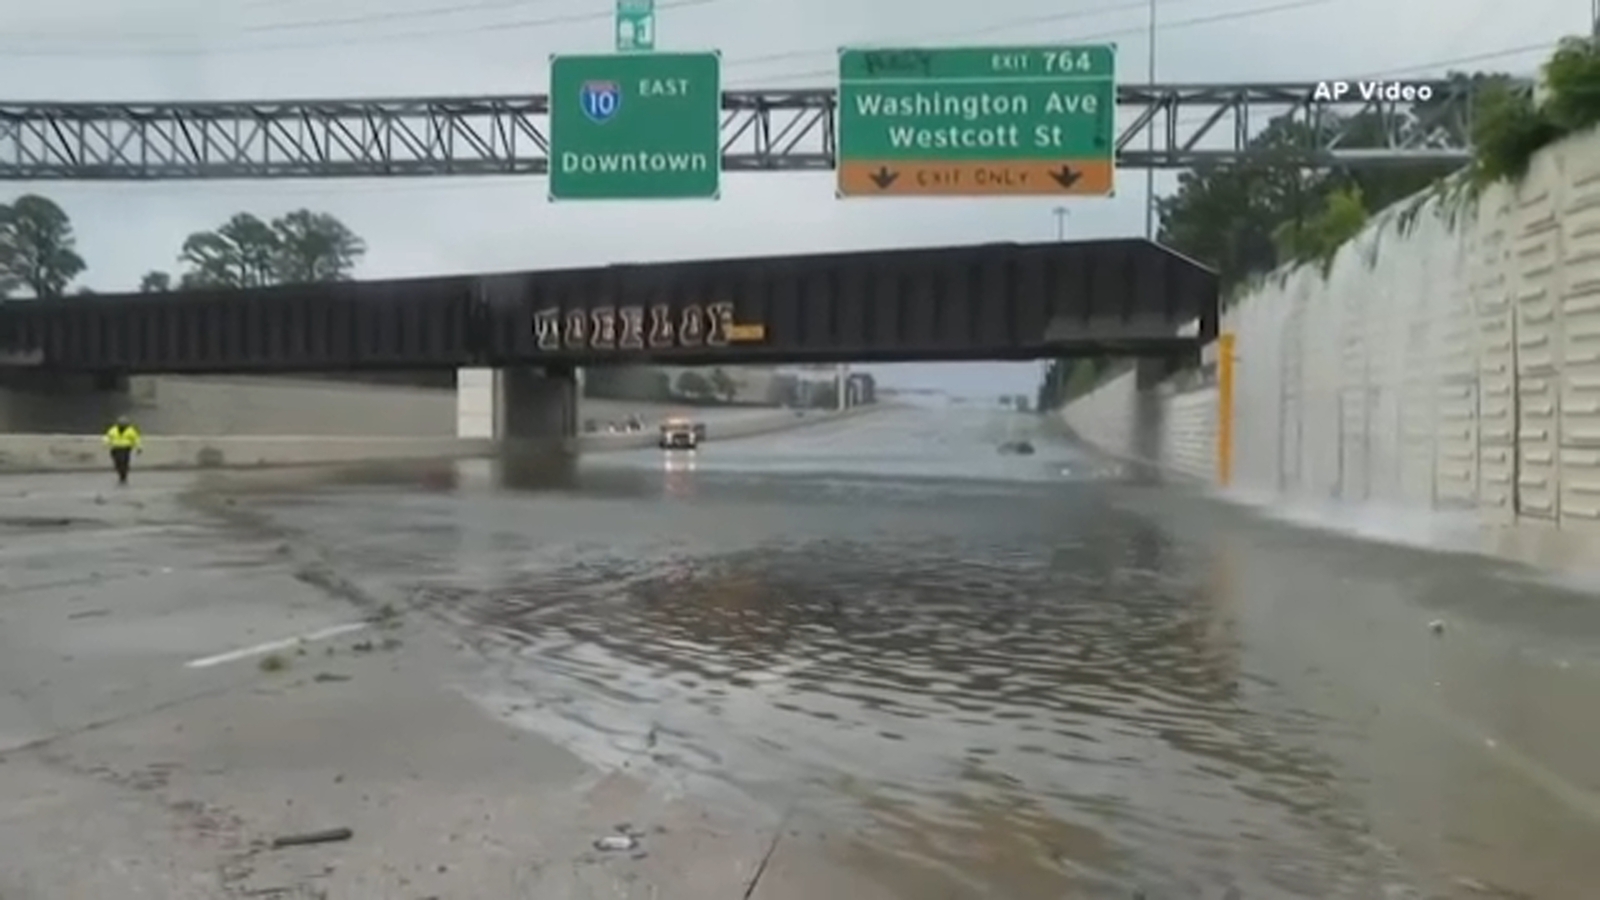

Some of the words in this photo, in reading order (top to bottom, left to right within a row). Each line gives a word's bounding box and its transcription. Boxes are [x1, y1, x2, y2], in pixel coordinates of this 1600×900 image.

[991, 53, 1028, 71] EXIT
[1043, 51, 1091, 72] 764
[638, 78, 689, 97] EAST
[590, 91, 614, 116] 10
[856, 92, 1028, 120] Washington
[1045, 91, 1098, 115] Ave
[889, 124, 1018, 148] Westcott
[1034, 124, 1063, 147] St
[561, 150, 707, 174] Downtown
[974, 167, 1029, 186] ONLY
